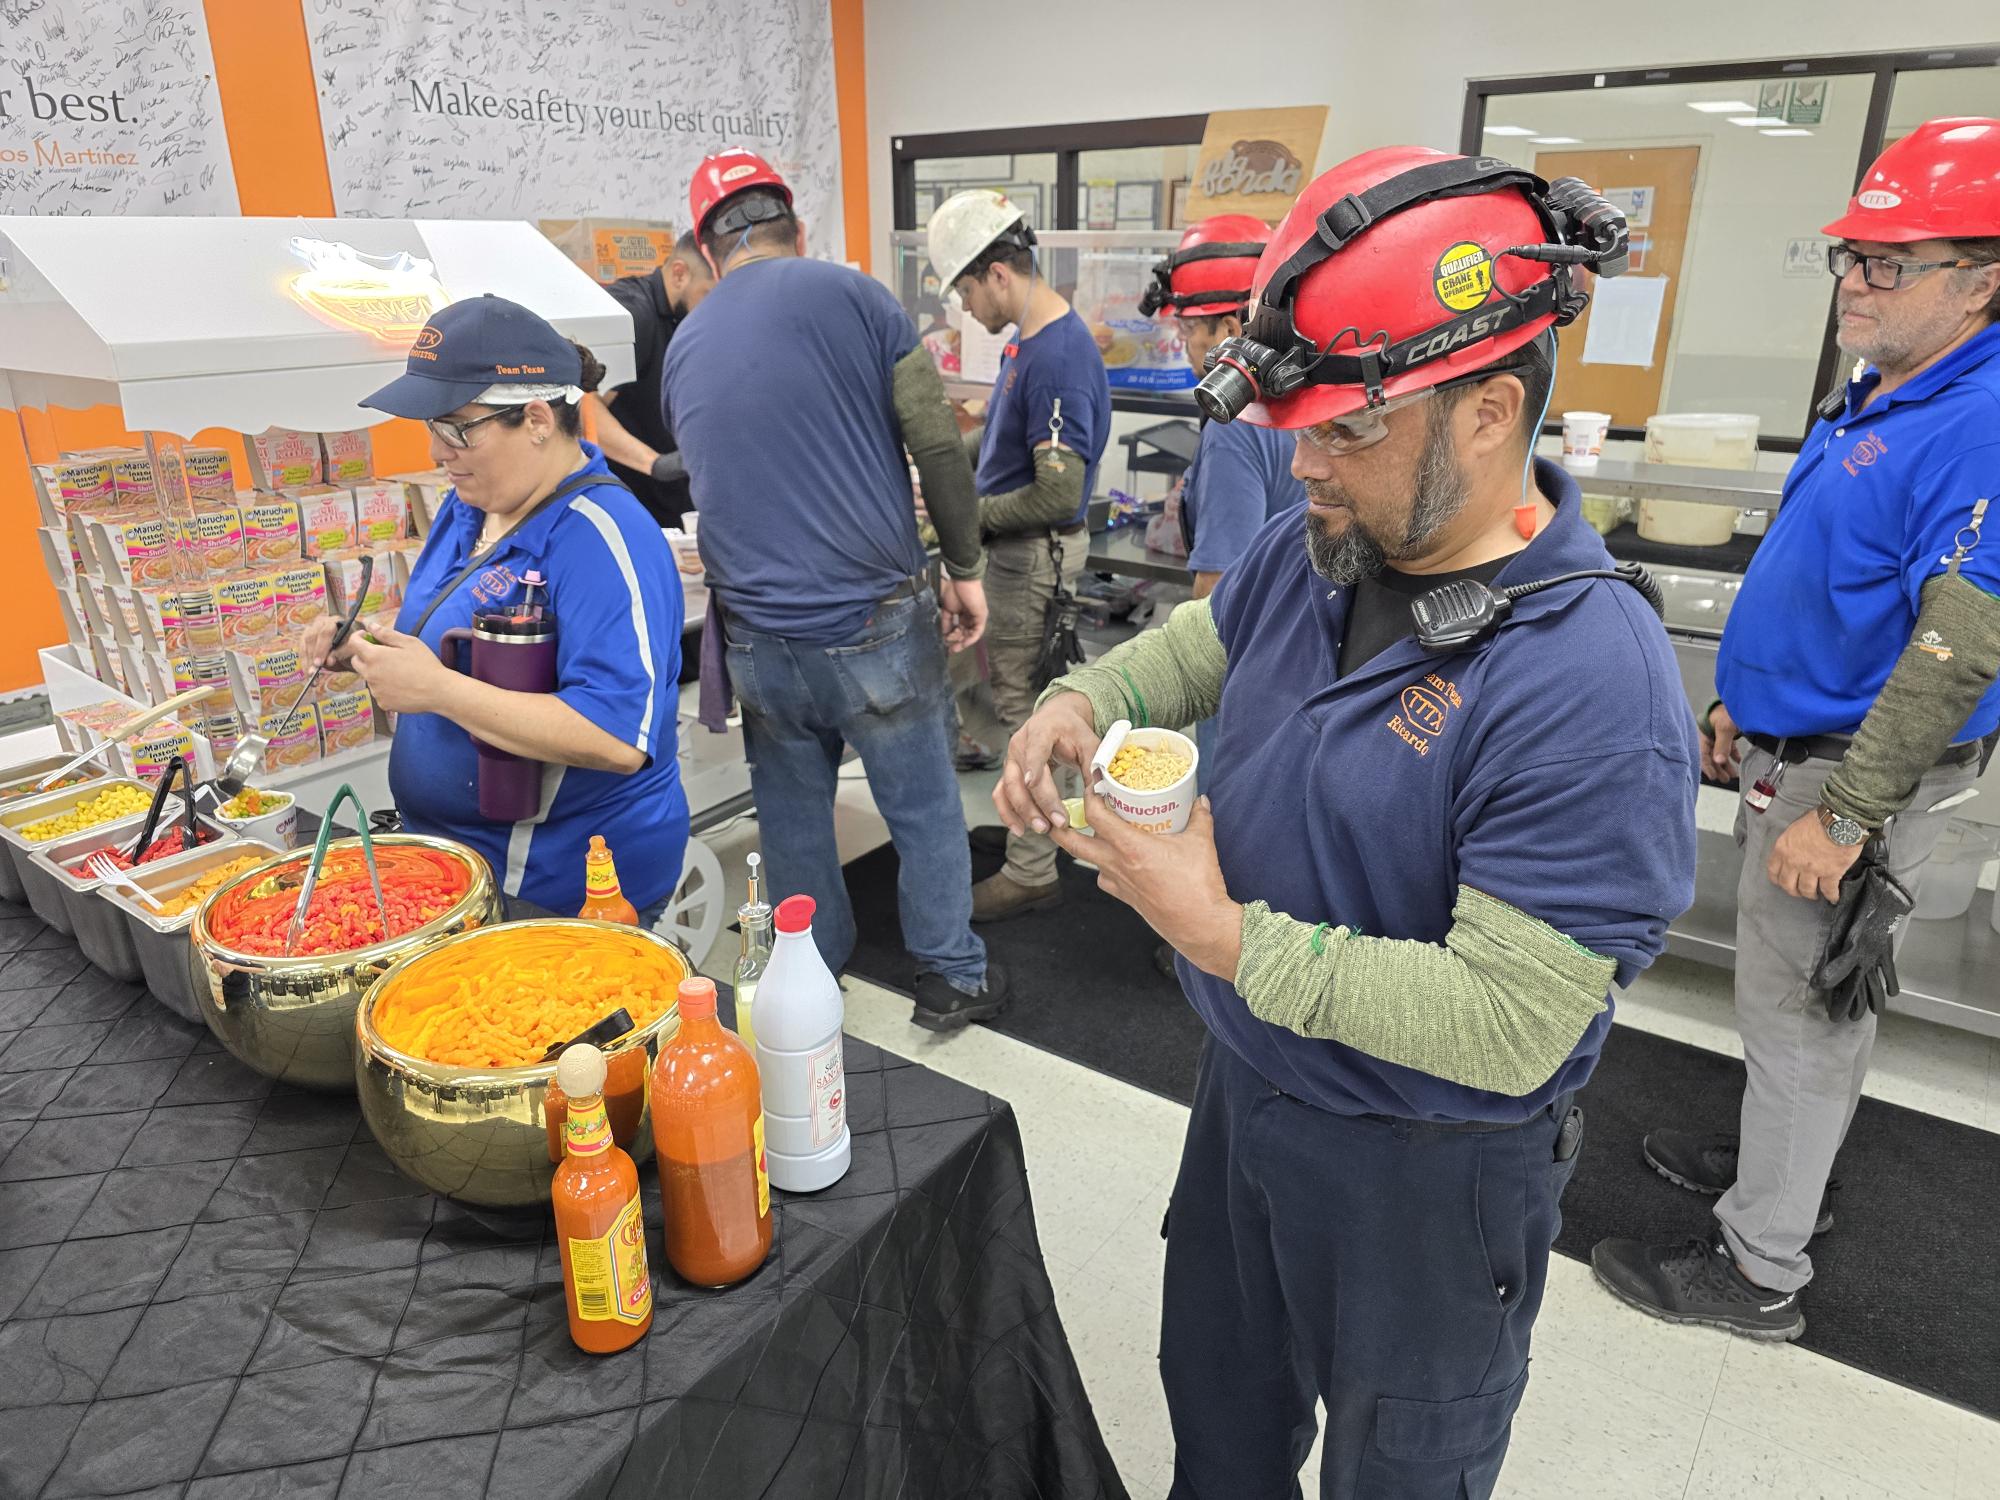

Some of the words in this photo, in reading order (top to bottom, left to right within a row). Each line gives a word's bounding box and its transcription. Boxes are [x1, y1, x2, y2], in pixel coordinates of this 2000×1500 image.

[23, 76, 138, 124] best.
[409, 79, 500, 119] Make
[506, 89, 588, 135] safety
[595, 103, 652, 137] your
[659, 100, 707, 134] best
[712, 107, 793, 146] quality.
[1440, 250, 1484, 277] QUALIFIED
[1442, 271, 1472, 291] CRANE
[1443, 281, 1475, 299] OPERATOR
[1405, 306, 1511, 366] COAST
[496, 363, 520, 375] Team
[521, 363, 545, 374] Texas
[190, 455, 228, 465] Maruchan
[67, 464, 108, 478] Maruchan
[124, 463, 151, 471] Maruc
[193, 463, 219, 471] Instant
[72, 474, 100, 484] Instant
[77, 480, 99, 489] Lunch
[253, 507, 294, 517] Maruchan
[258, 515, 285, 524] Instant
[261, 521, 283, 529] Lunch
[139, 532, 164, 542] Instan
[283, 570, 321, 582] Maruchan
[227, 580, 269, 593] Maruchan
[287, 579, 313, 589] Instant
[290, 585, 311, 594] Lunch
[232, 589, 260, 599] Instant
[236, 596, 258, 605] Lunch
[270, 660, 297, 672] Instant
[274, 667, 296, 677] Lunch
[330, 693, 367, 709] Maruchan
[337, 710, 358, 720] Lunch
[1408, 690, 1445, 731] TTTX
[1387, 714, 1430, 756] Ricardo
[144, 736, 189, 752] Maruchan
[149, 746, 180, 759] Instant
